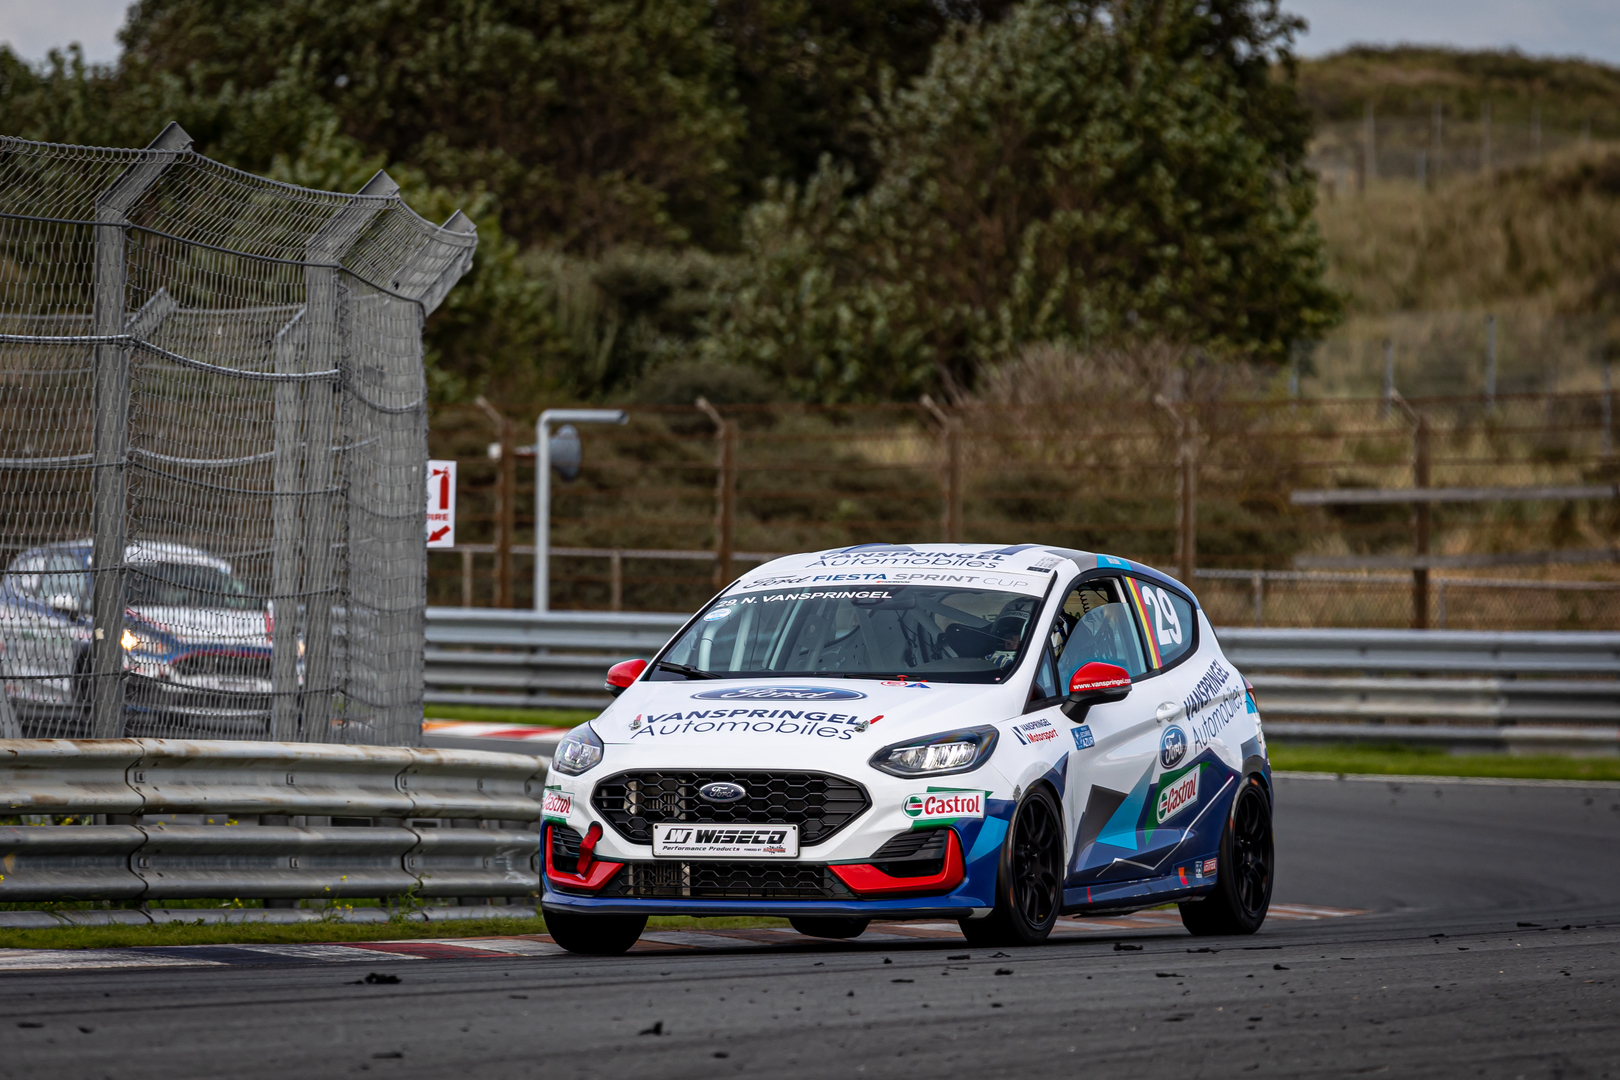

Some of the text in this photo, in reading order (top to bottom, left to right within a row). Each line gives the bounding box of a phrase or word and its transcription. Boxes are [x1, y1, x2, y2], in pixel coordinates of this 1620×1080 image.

[805, 556, 999, 569] Automobiles
[743, 573, 1028, 588] Ford FIESTA SPRINT CUP
[763, 591, 892, 602] VANSPRINGEL
[1141, 585, 1182, 646] 29
[720, 687, 836, 699] Ford
[1183, 659, 1230, 721] VANSPRINGEL
[647, 709, 862, 726] VANSPRINGEL
[1192, 685, 1243, 755] Automobiles
[631, 719, 855, 741] Automobiles
[1164, 732, 1183, 765] Ford
[709, 786, 735, 798] Ford
[1167, 772, 1197, 813] Castrol
[924, 795, 981, 815] Castrol
